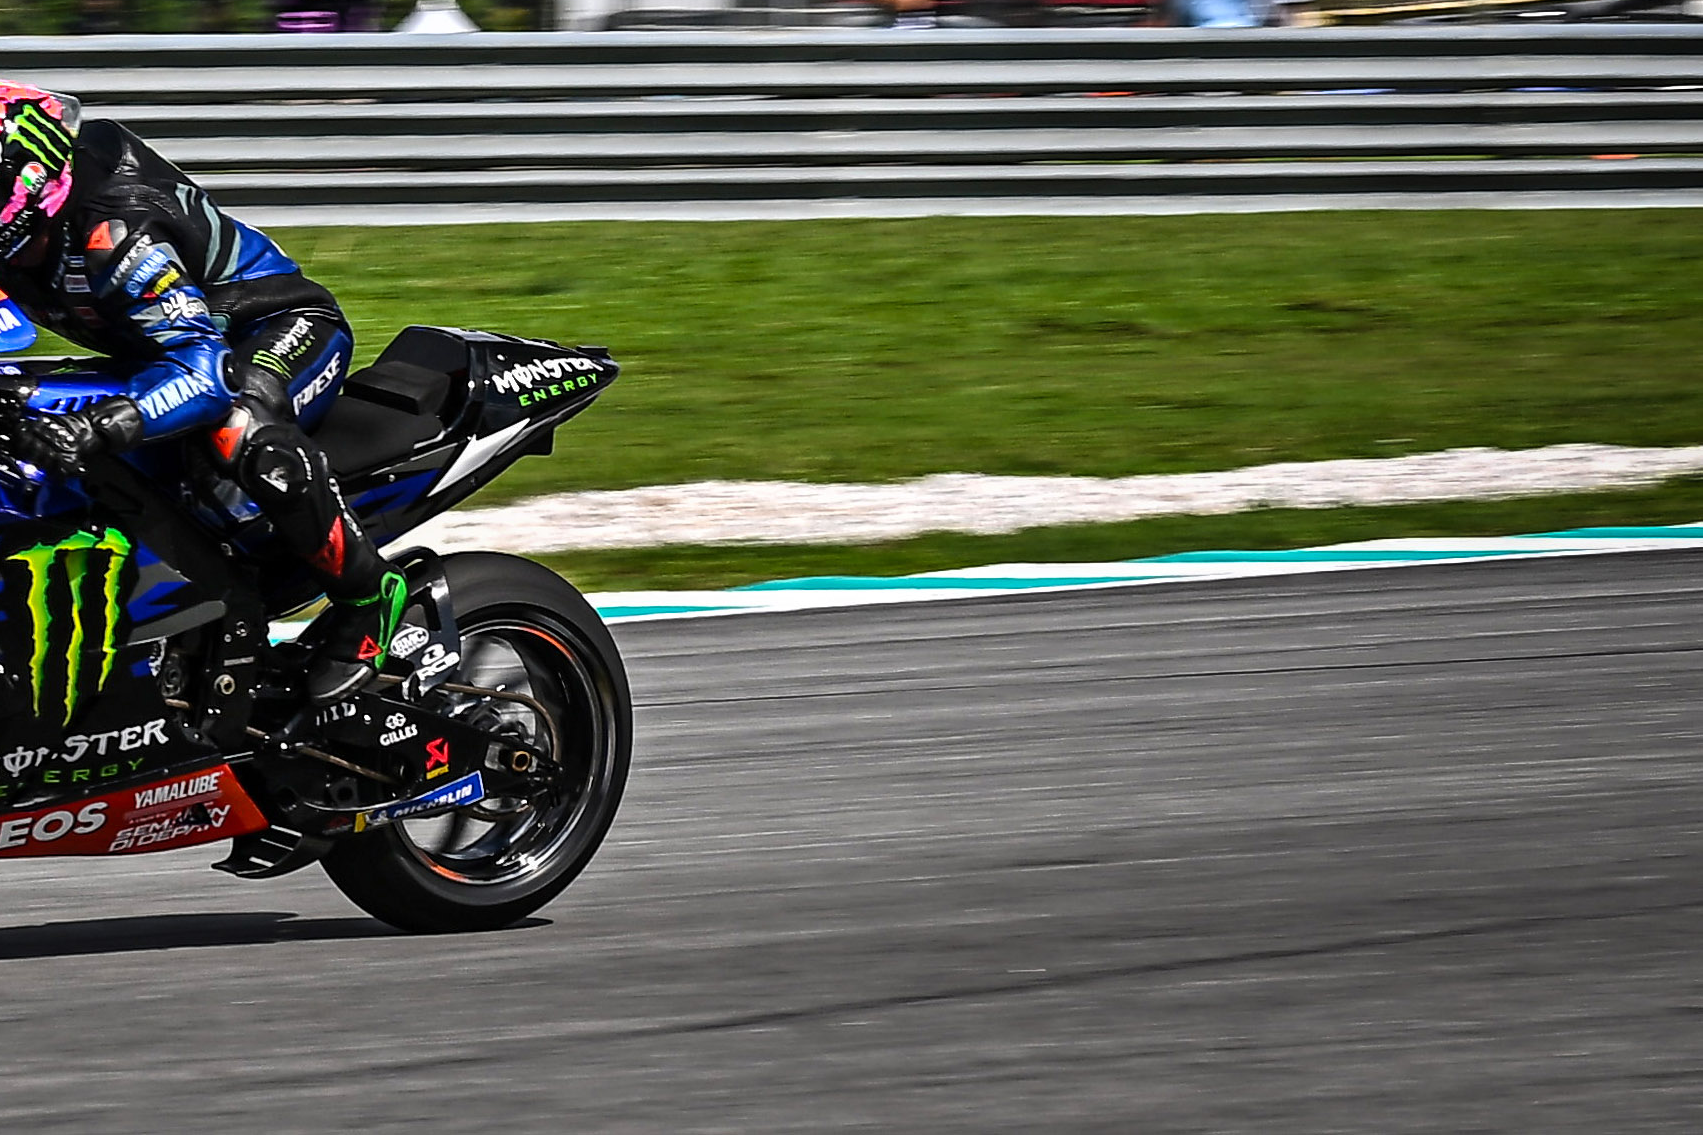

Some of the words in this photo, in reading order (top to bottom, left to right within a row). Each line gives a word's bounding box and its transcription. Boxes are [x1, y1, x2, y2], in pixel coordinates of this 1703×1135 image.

[492, 357, 604, 393] MONSTER
[518, 373, 598, 407] ENERGY
[379, 724, 418, 747] GILLES
[134, 771, 223, 809] YAMALUBE
[393, 784, 473, 818] MICHELIN
